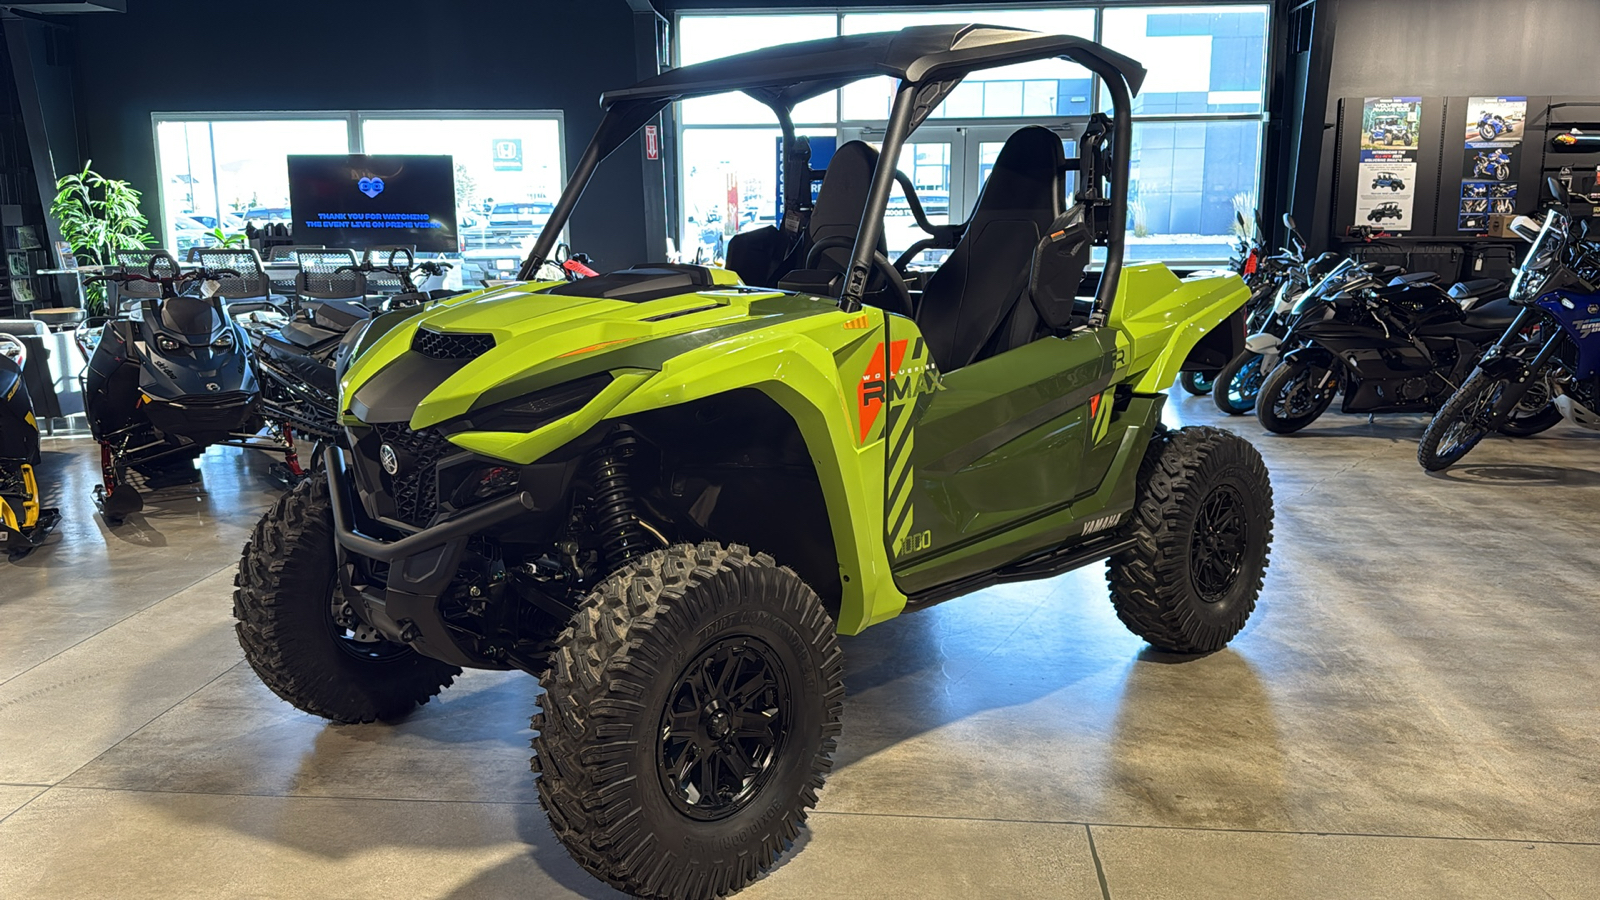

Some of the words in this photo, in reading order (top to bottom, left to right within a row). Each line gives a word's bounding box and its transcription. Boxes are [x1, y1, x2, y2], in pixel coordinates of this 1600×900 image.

[862, 363, 935, 381] WOLVERINE
[1081, 512, 1122, 537] YAMAHA
[900, 529, 931, 556] 1000
